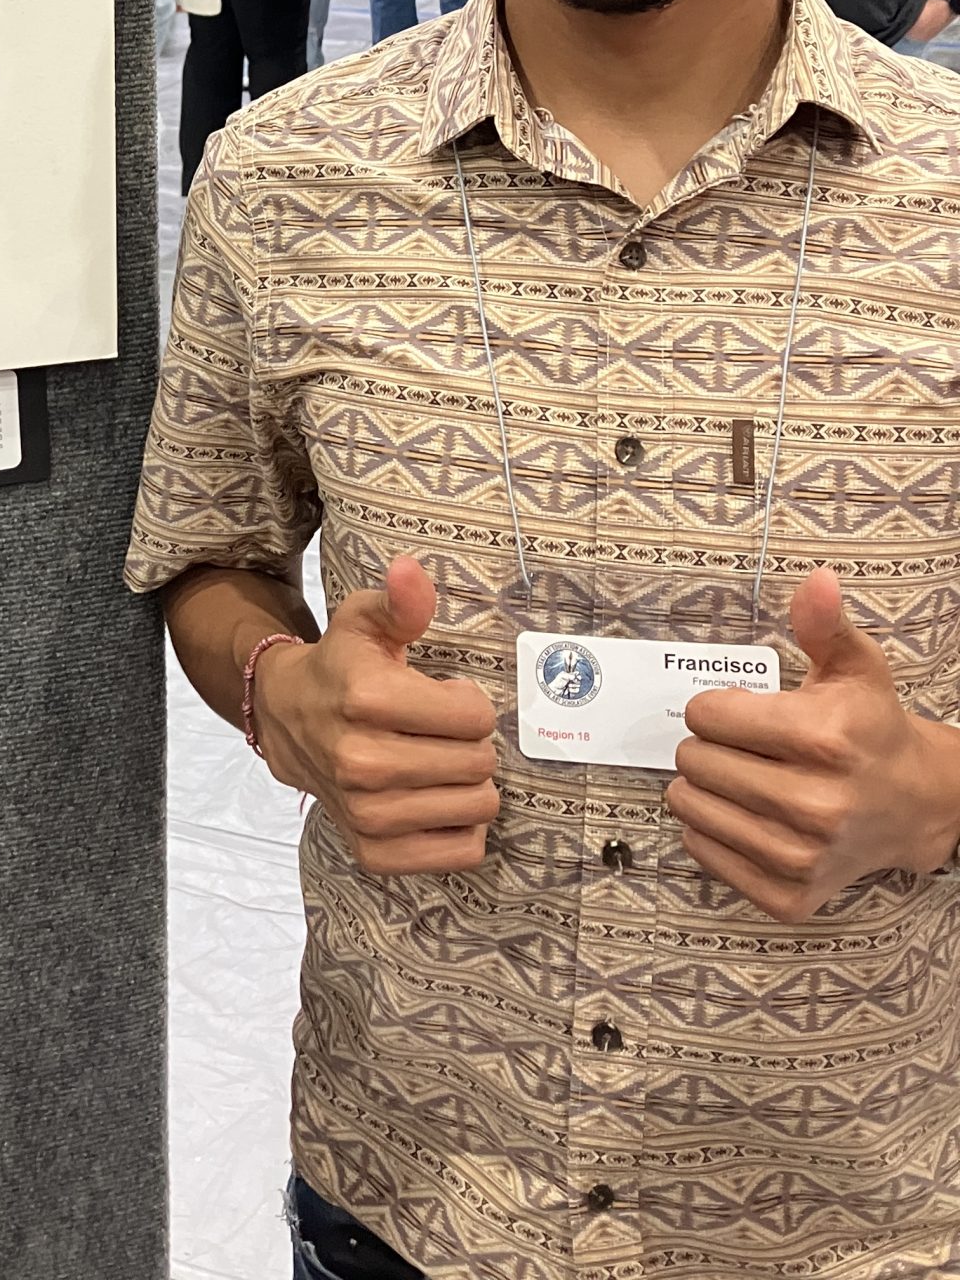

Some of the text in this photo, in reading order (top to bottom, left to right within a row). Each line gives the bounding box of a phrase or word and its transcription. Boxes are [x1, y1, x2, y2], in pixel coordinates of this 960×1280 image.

[664, 653, 768, 674] Francisco
[692, 677, 769, 689] Francisco Rosas
[538, 727, 591, 742] Region 18
